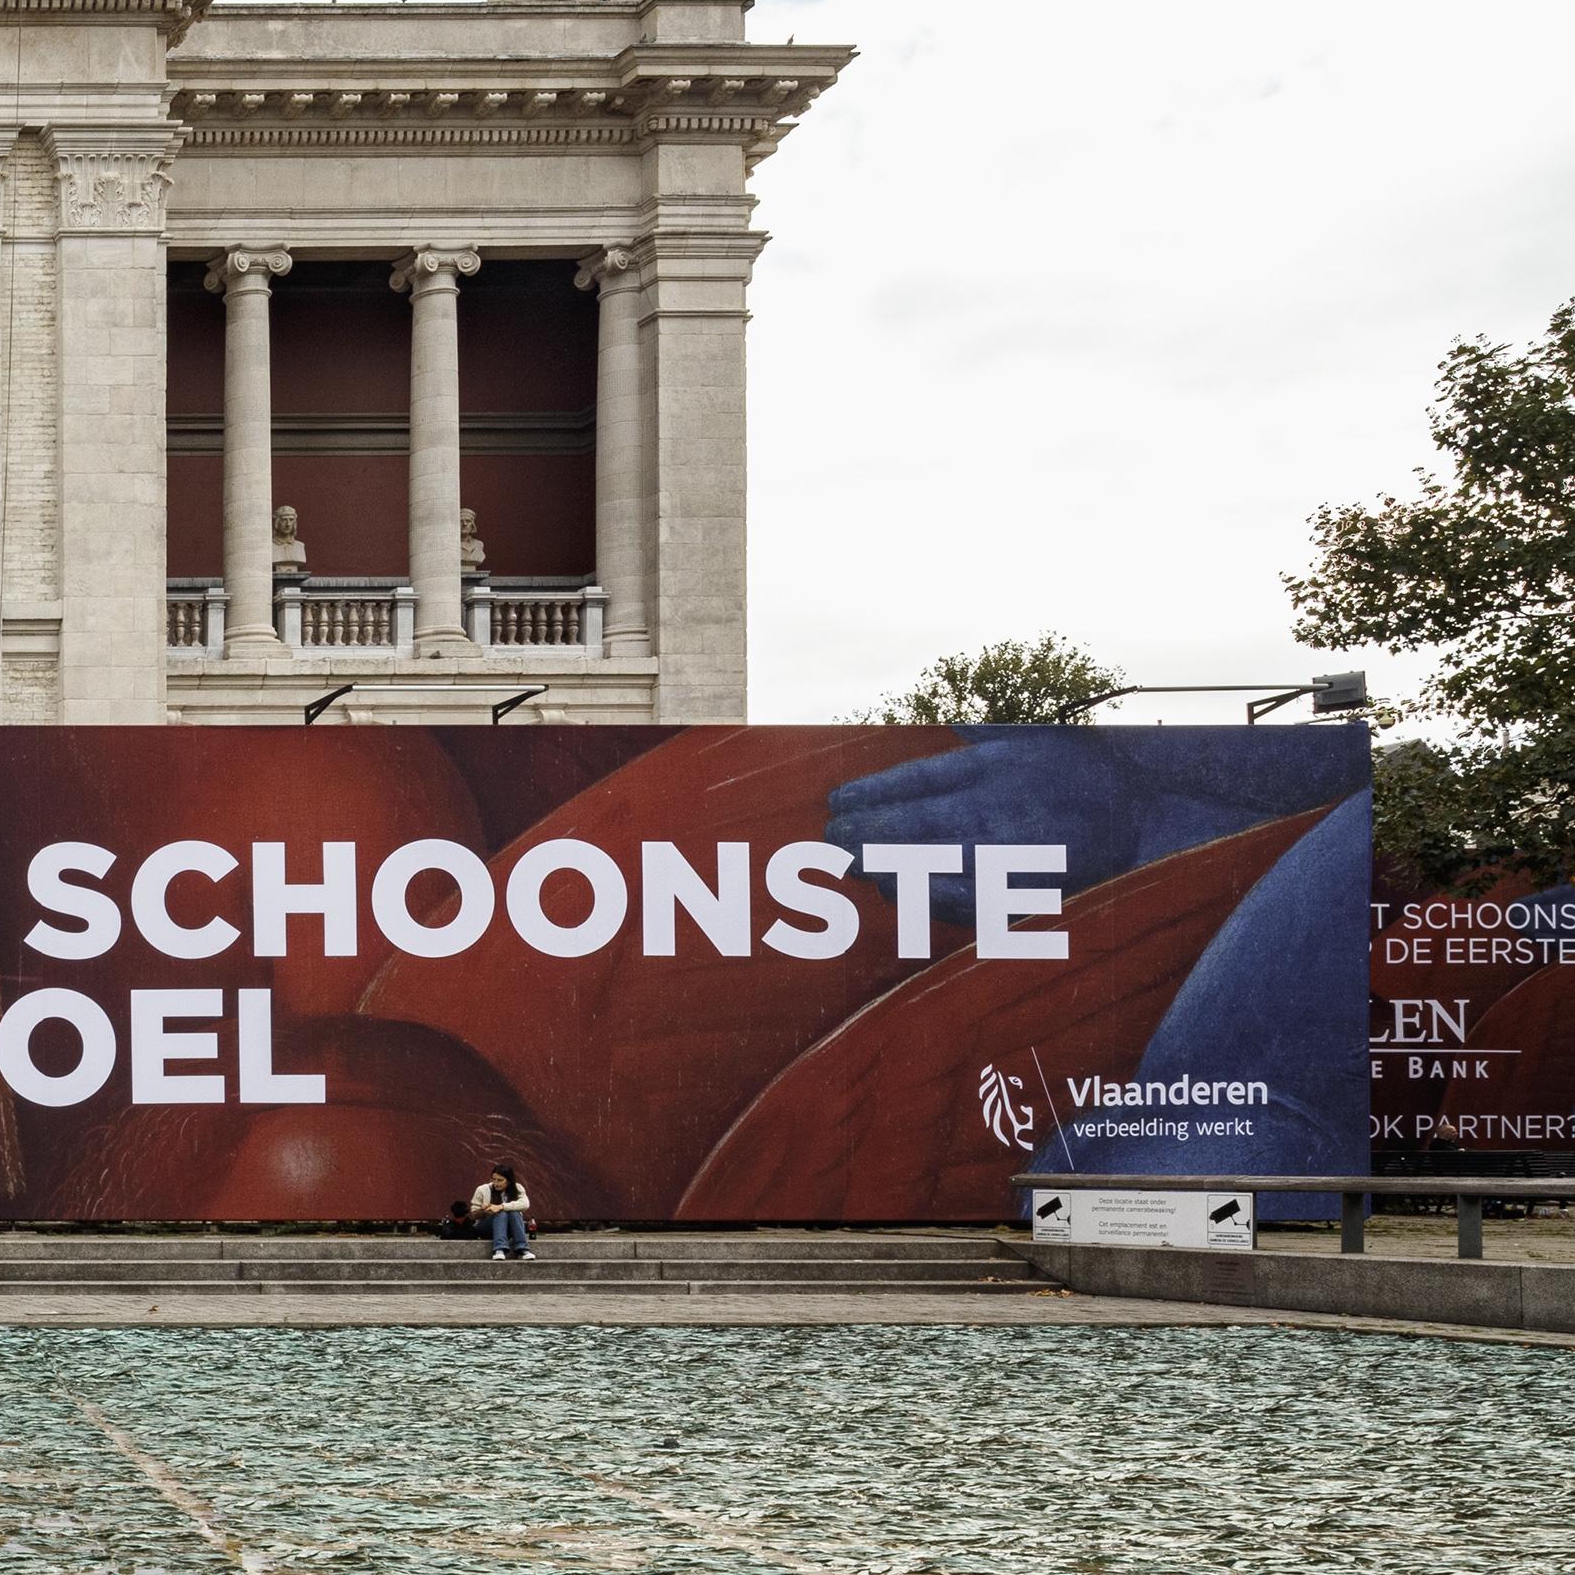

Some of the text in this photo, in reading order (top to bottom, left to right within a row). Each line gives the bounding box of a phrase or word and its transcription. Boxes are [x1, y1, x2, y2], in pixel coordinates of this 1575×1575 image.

[23, 838, 1069, 960] SCHOONSTE
[1386, 938, 1575, 964] DE EERSTE
[1408, 1056, 1489, 1079] BANK
[1067, 1074, 1268, 1107] Vlaanderen
[1074, 1117, 1254, 1141] verbeelding werkt
